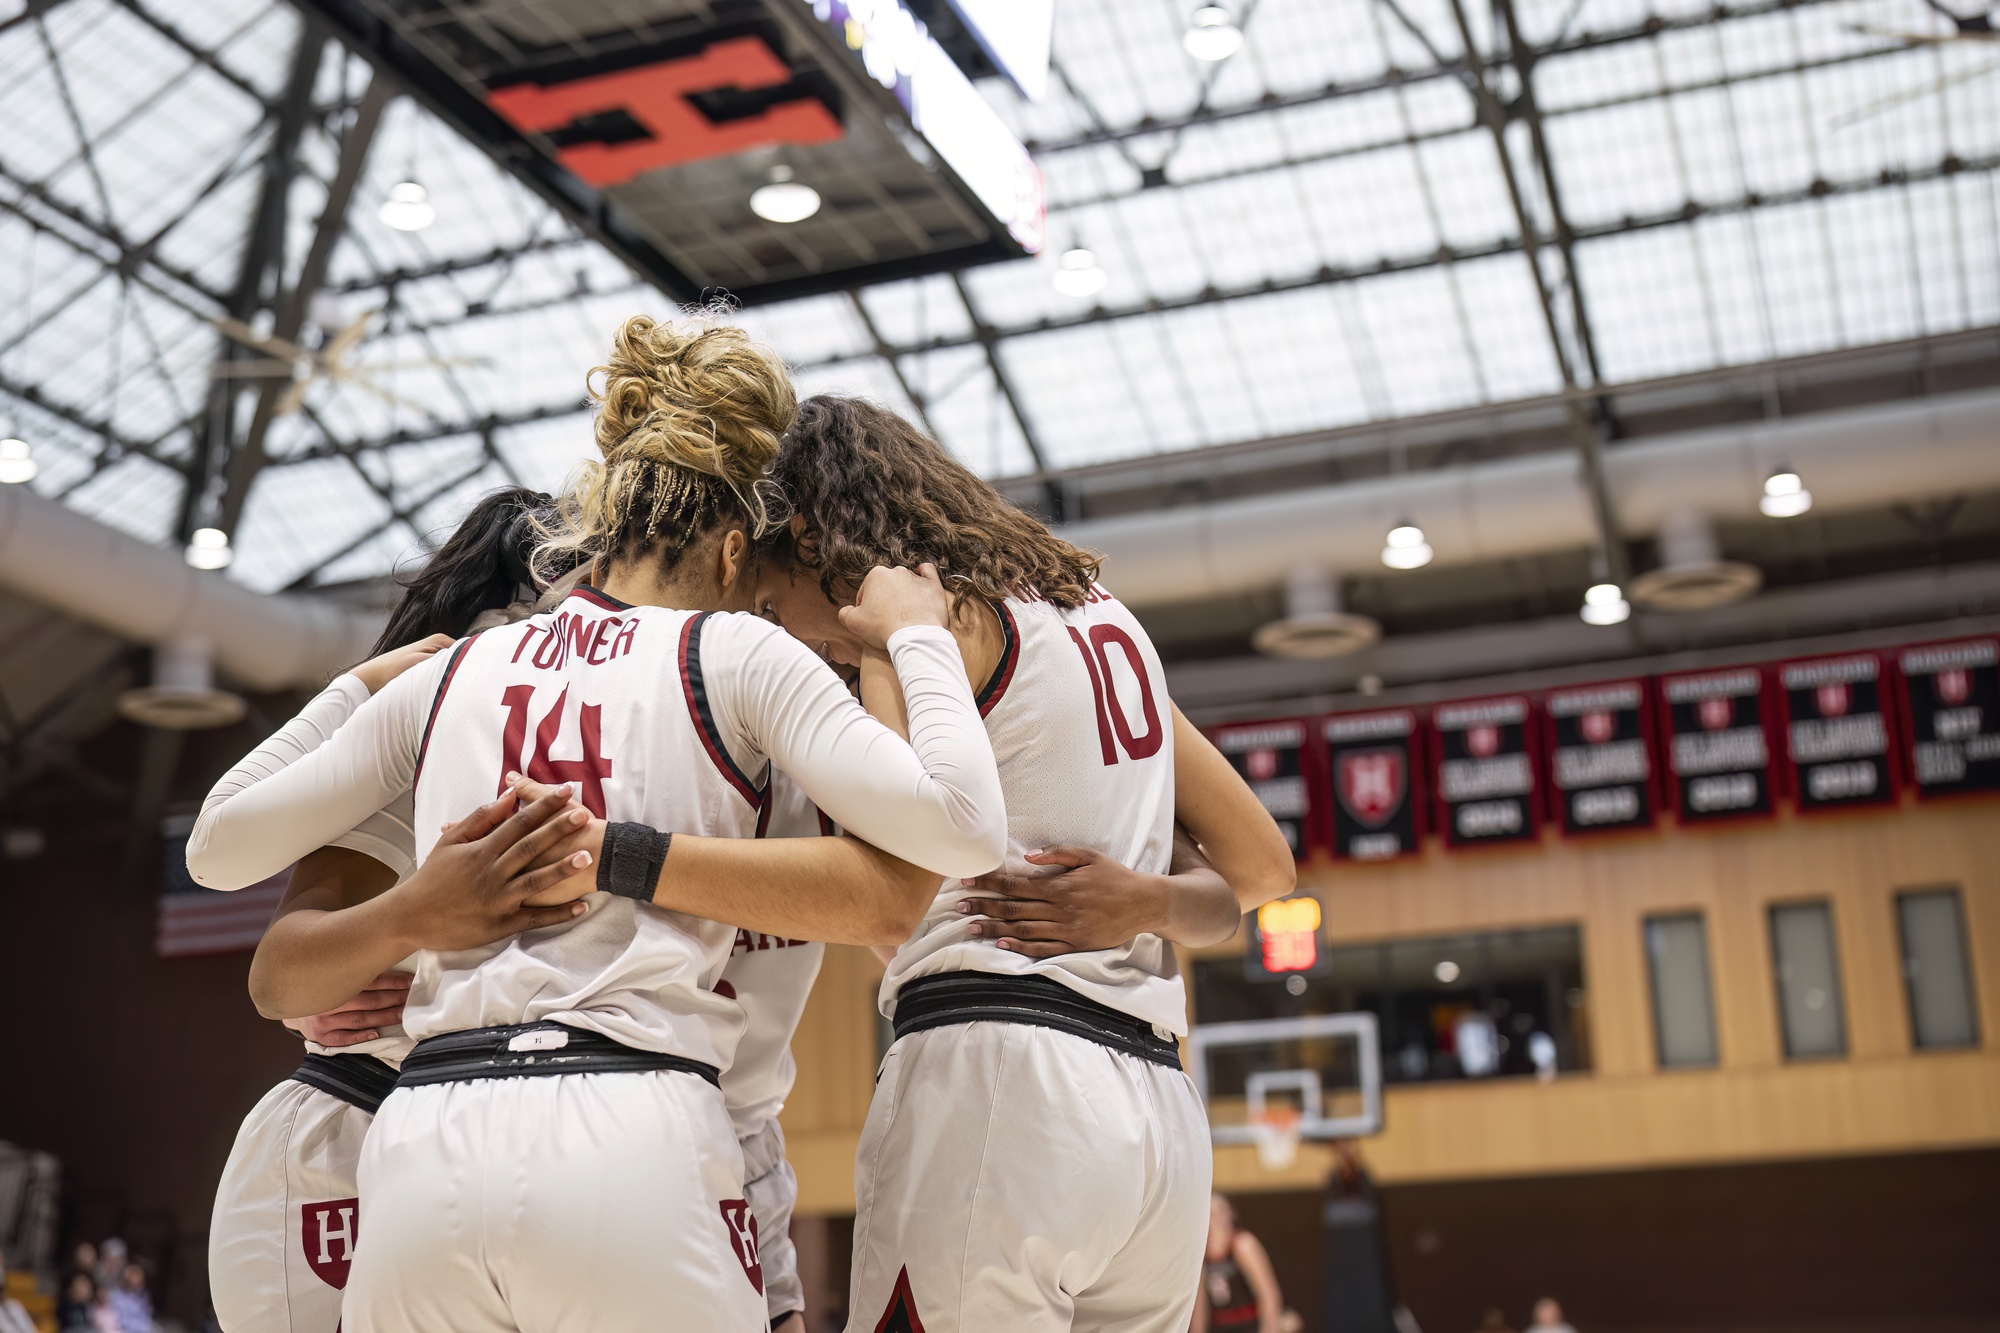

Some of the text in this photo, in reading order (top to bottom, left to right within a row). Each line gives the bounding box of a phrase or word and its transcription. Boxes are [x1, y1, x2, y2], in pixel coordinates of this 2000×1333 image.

[1066, 623, 1163, 766] 10
[497, 681, 612, 820] 14
[316, 1207, 353, 1264] H
[727, 1206, 760, 1268] H
